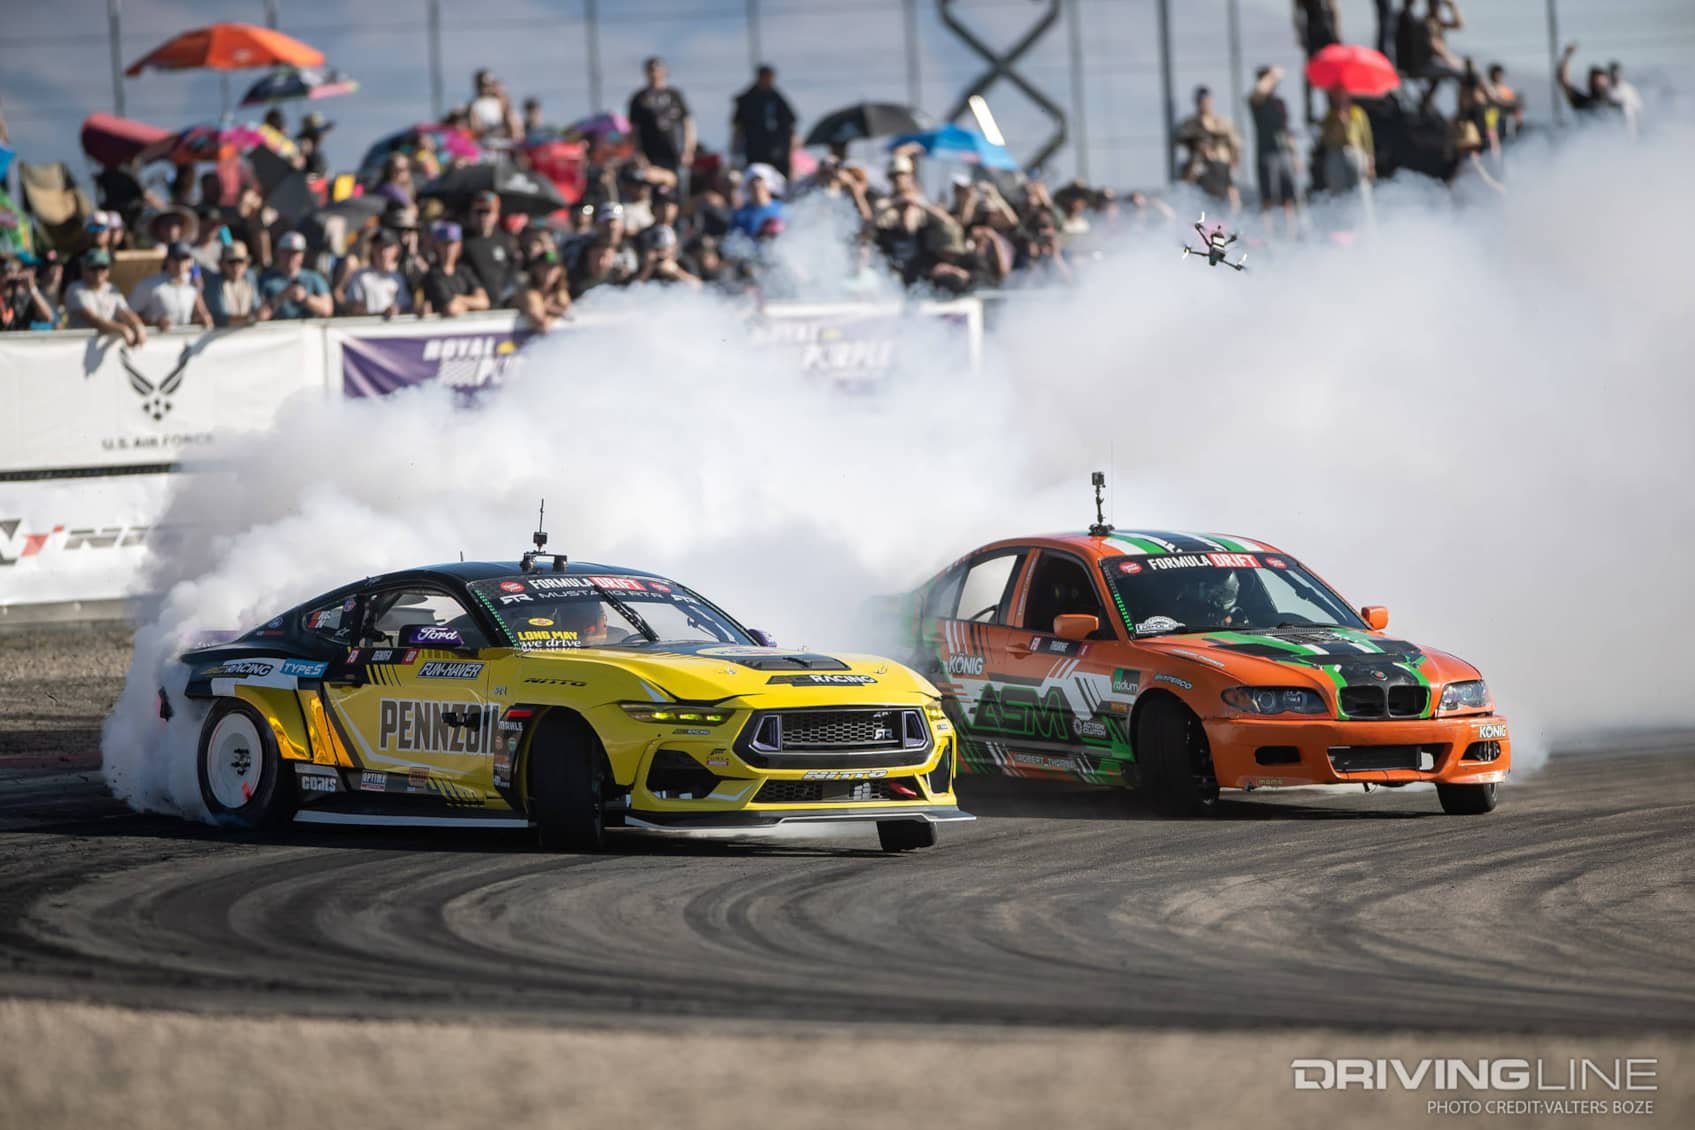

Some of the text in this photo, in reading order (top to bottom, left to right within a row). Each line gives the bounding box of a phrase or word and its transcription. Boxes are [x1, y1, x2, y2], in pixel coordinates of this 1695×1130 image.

[133, 436, 158, 448] AIR
[1147, 555, 1213, 570] FORMULA
[1209, 553, 1258, 568] DRIFT
[528, 578, 597, 590] FORMULA
[596, 577, 644, 590] DRIFT
[417, 627, 458, 640] Ford
[552, 631, 578, 641] MAY
[546, 638, 582, 648] drive
[419, 662, 482, 677] FUN-HAVER
[808, 674, 876, 684] RACING
